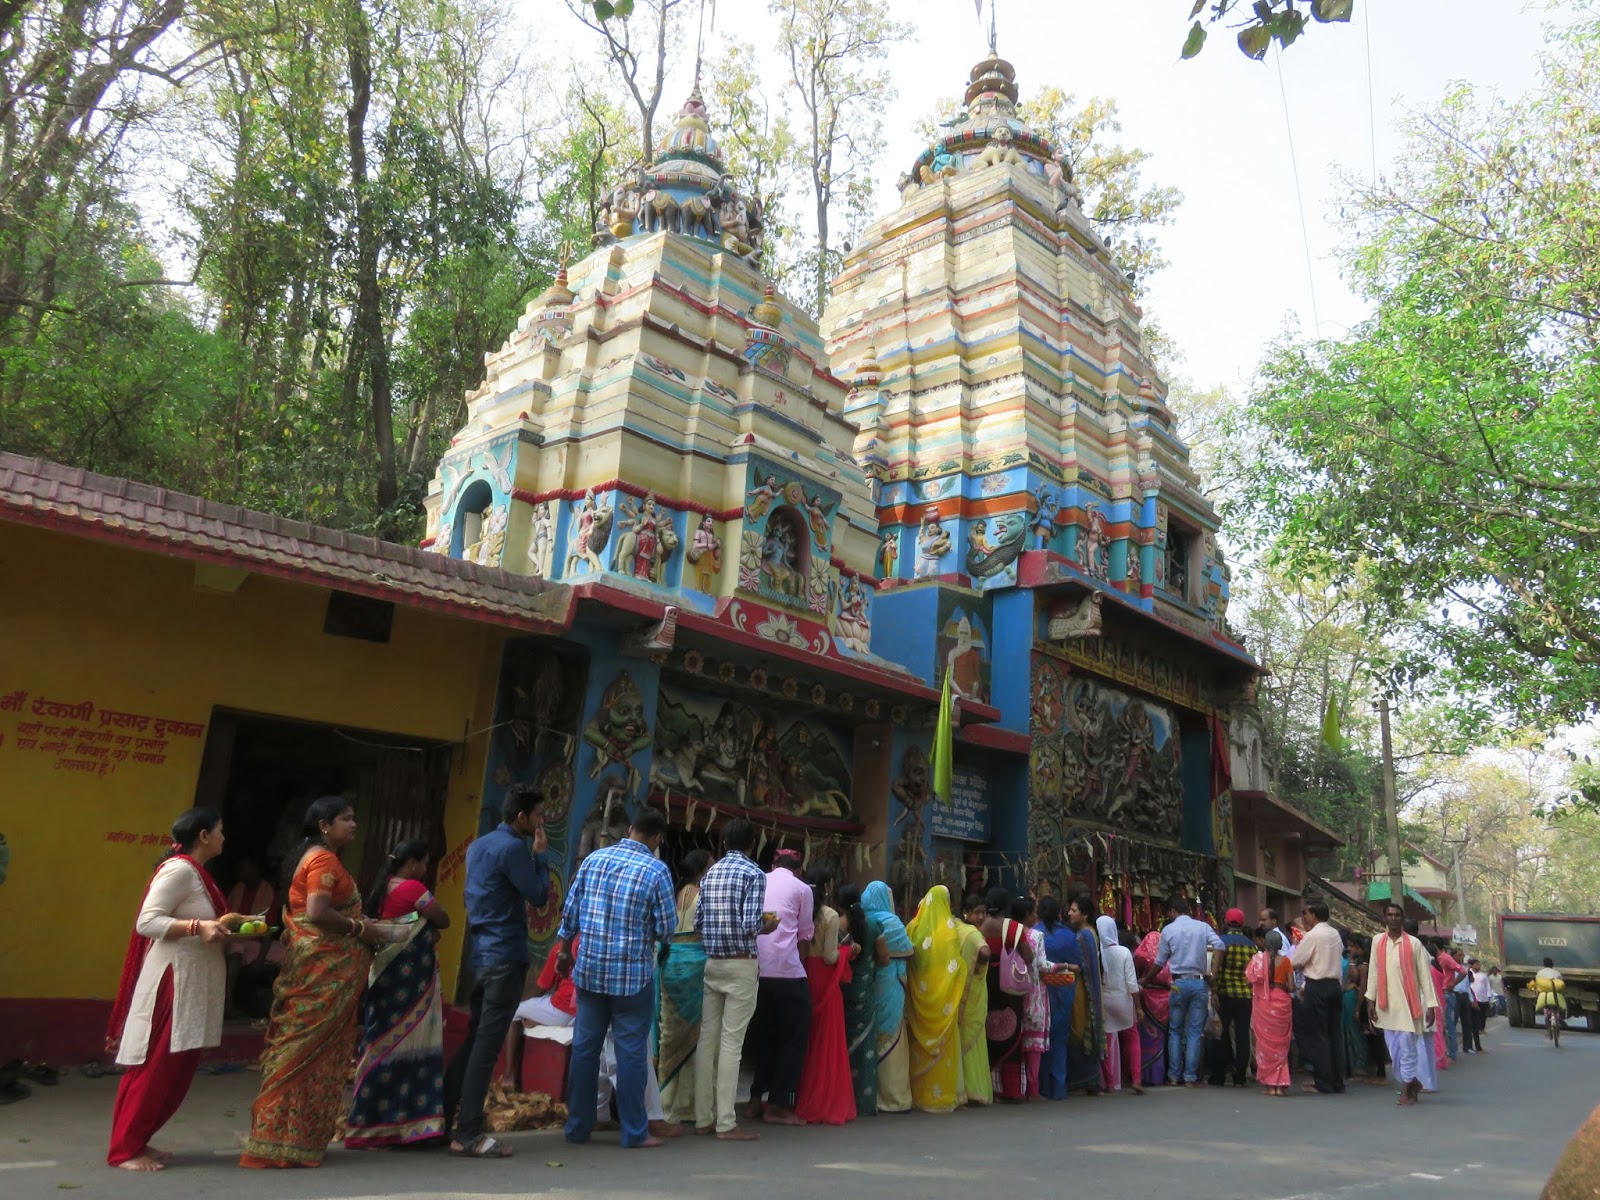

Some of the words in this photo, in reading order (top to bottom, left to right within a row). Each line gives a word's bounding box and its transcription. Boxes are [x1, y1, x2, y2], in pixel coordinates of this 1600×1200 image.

[98, 709, 151, 733] प्रसाद
[153, 718, 205, 738] दुकान
[1539, 937, 1566, 946] TATA
